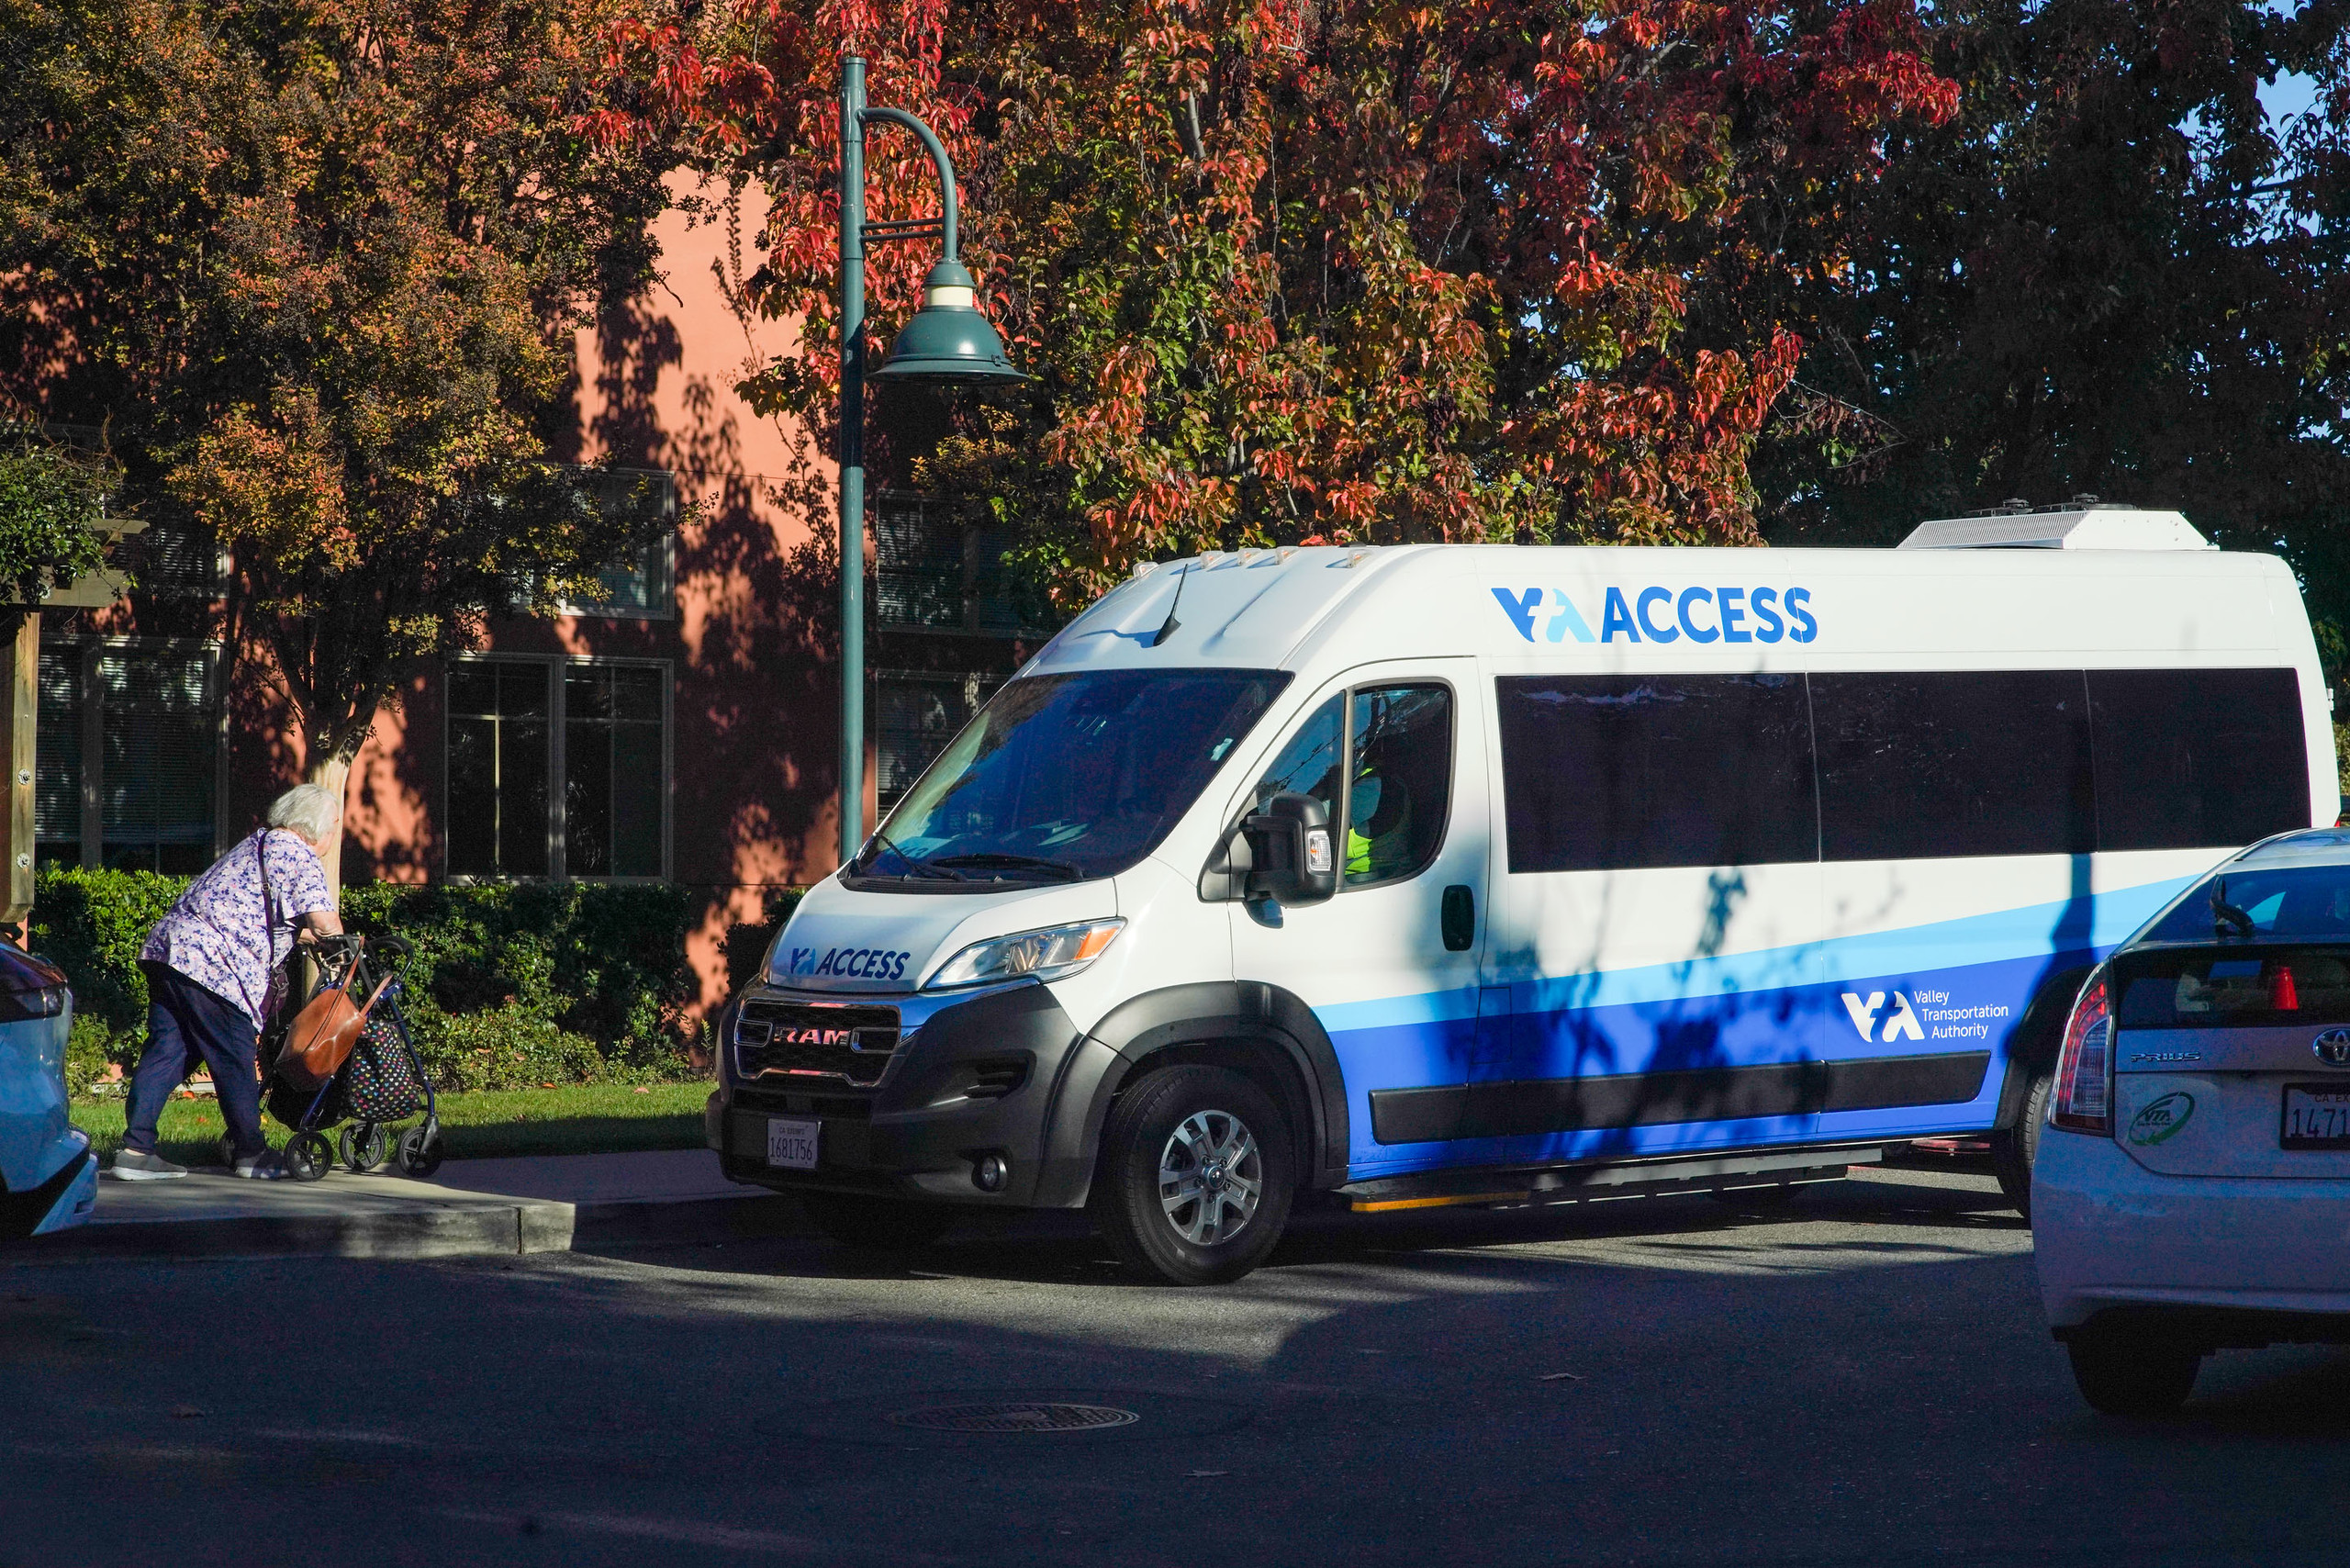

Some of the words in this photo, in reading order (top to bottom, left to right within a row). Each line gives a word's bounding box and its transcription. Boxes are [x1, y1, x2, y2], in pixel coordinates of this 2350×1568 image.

[1601, 586, 1818, 644] ACCESS
[815, 948, 911, 980] ACCESS
[1914, 990, 1950, 1006] Valley
[1921, 1003, 2009, 1023] Transportation
[774, 1026, 851, 1046] RAM
[1931, 1023, 1989, 1040] Authority
[2131, 1051, 2201, 1062] PRIUS
[2314, 1093, 2329, 1103] CA
[2335, 1093, 2350, 1103] EX
[2290, 1108, 2350, 1137] 1471
[770, 1137, 812, 1160] 1681756
